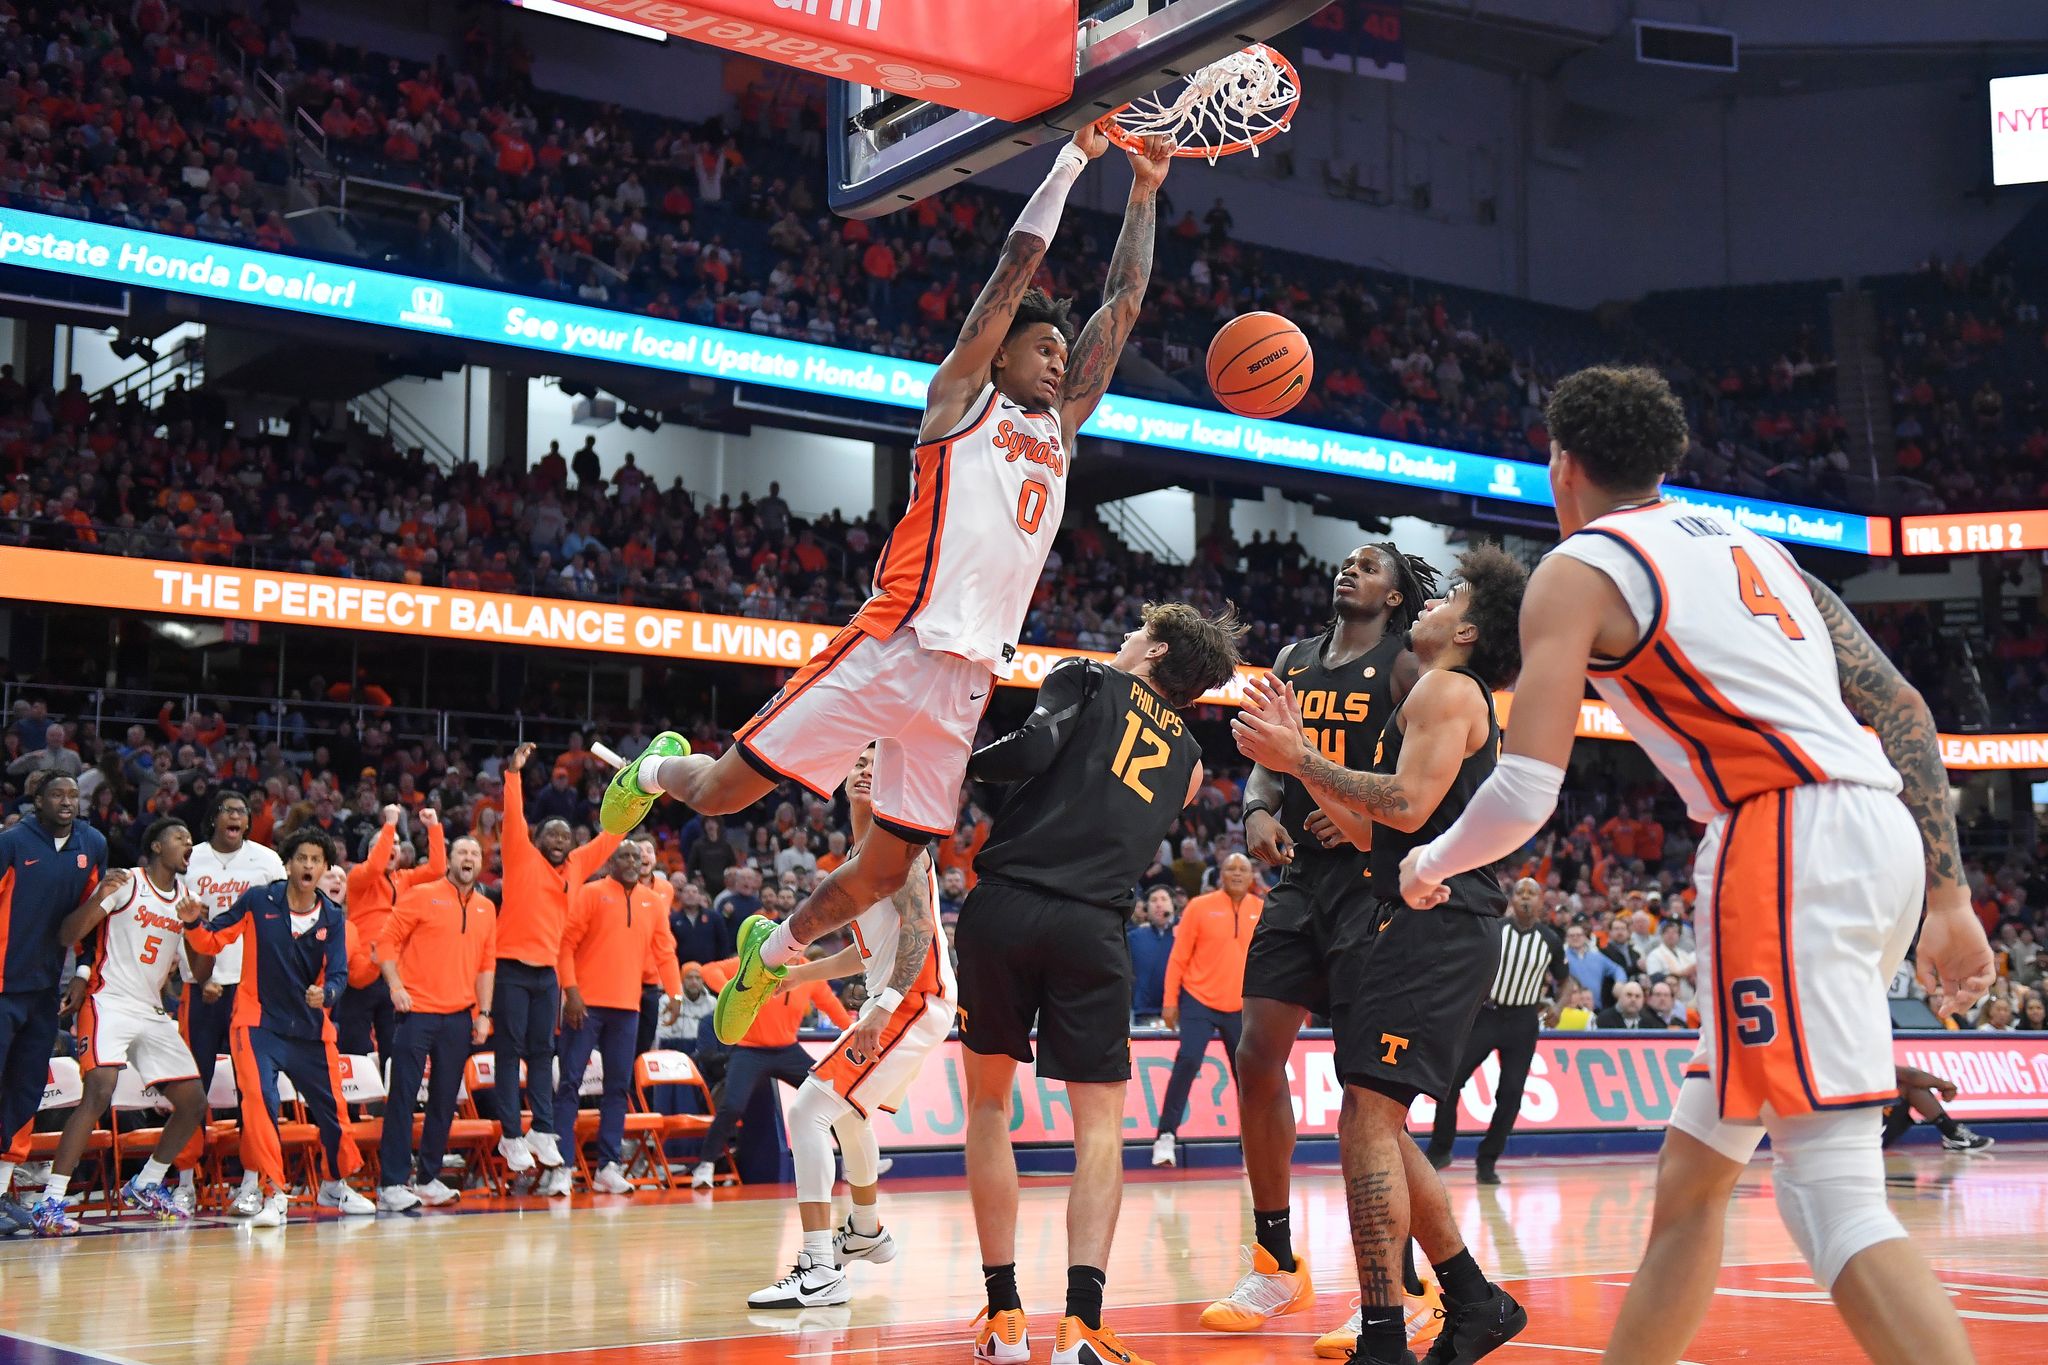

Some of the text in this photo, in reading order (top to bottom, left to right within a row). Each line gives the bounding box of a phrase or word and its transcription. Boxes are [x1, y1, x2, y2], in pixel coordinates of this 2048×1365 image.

[590, 0, 877, 74] State Far
[117, 242, 231, 288] Honda
[238, 263, 357, 308] Dealer!
[504, 307, 929, 398] See your local Upstate Honda De
[1247, 346, 1289, 375] SYRACUSE
[1096, 403, 1457, 482] See your local Upstate Honda Dealer!
[1016, 478, 1048, 535] 0
[1787, 514, 1844, 542] Dealer!
[2008, 523, 2023, 549] 2
[154, 569, 830, 661] THE PERFECT BALANCE OF LIVING &
[1729, 545, 1806, 640] 4
[1130, 681, 1183, 737] PHILLIPS
[1580, 705, 1624, 734] THE
[1111, 709, 1171, 804] 12
[1300, 763, 1396, 807] FEARLESS
[197, 875, 250, 897] Poetry
[217, 895, 232, 908] 21
[139, 935, 163, 965] 5
[1731, 976, 1778, 1048] S
[1380, 1032, 1410, 1065] T
